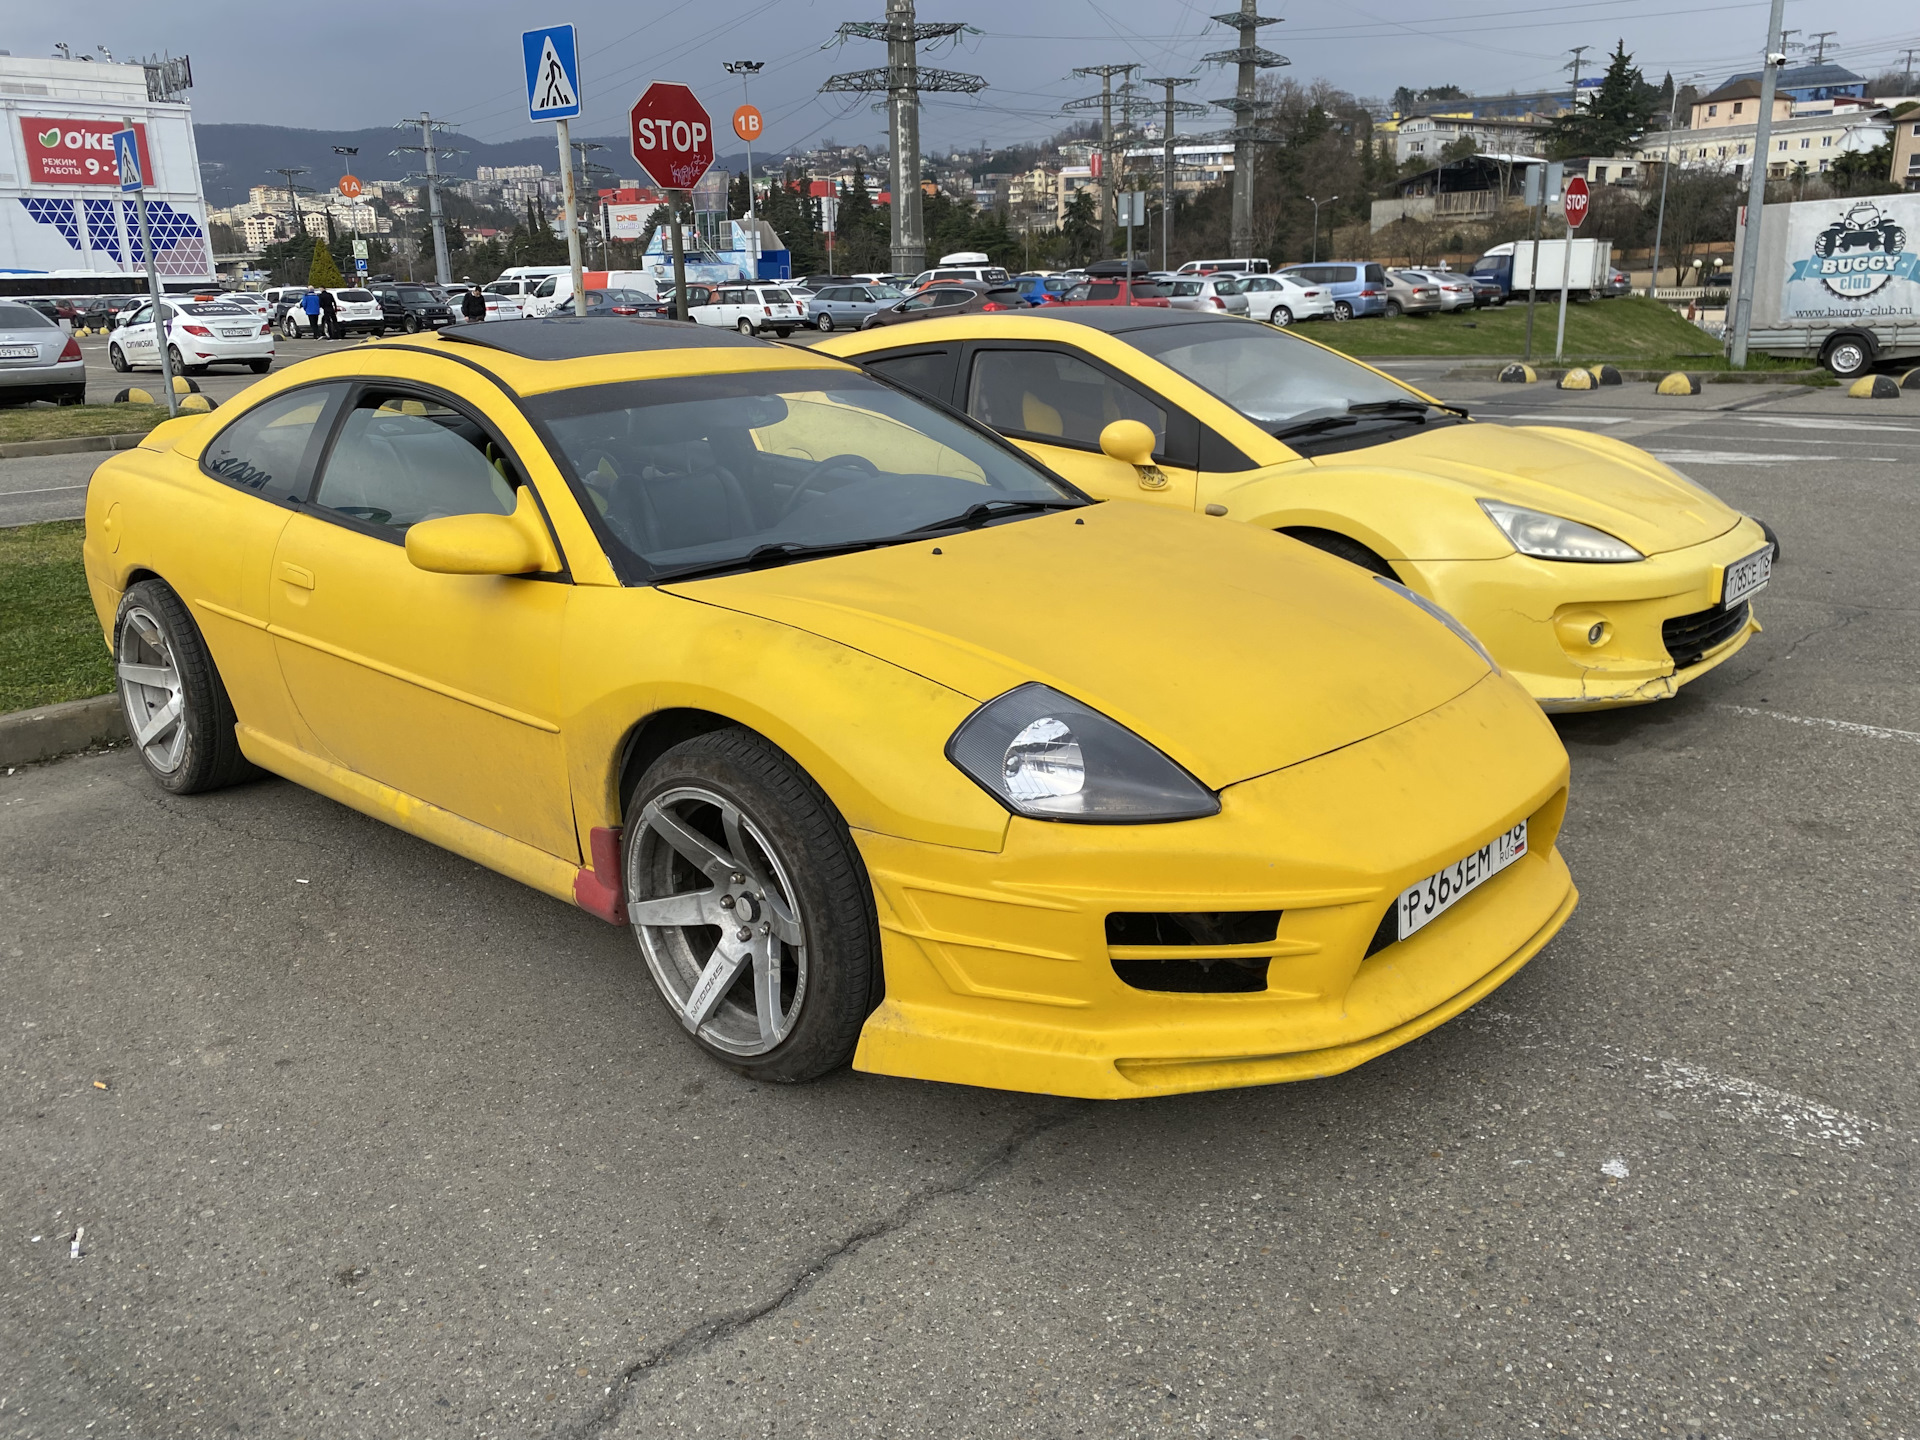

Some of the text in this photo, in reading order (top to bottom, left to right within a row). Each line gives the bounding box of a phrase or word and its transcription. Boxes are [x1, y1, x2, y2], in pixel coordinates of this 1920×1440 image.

[738, 115, 760, 131] 1B
[64, 129, 115, 150] О'КЕ
[639, 118, 707, 152] STOP
[42, 157, 77, 167] РЕЖИМ
[44, 166, 82, 175] РАБОТЫ
[342, 181, 360, 192] 1A
[1566, 194, 1587, 210] STOP
[616, 214, 638, 222] DNS
[1821, 256, 1901, 274] BUGGY
[1840, 274, 1872, 290] club
[1795, 305, 1913, 318] www.buggy-club.ru
[1499, 845, 1515, 865] RUS
